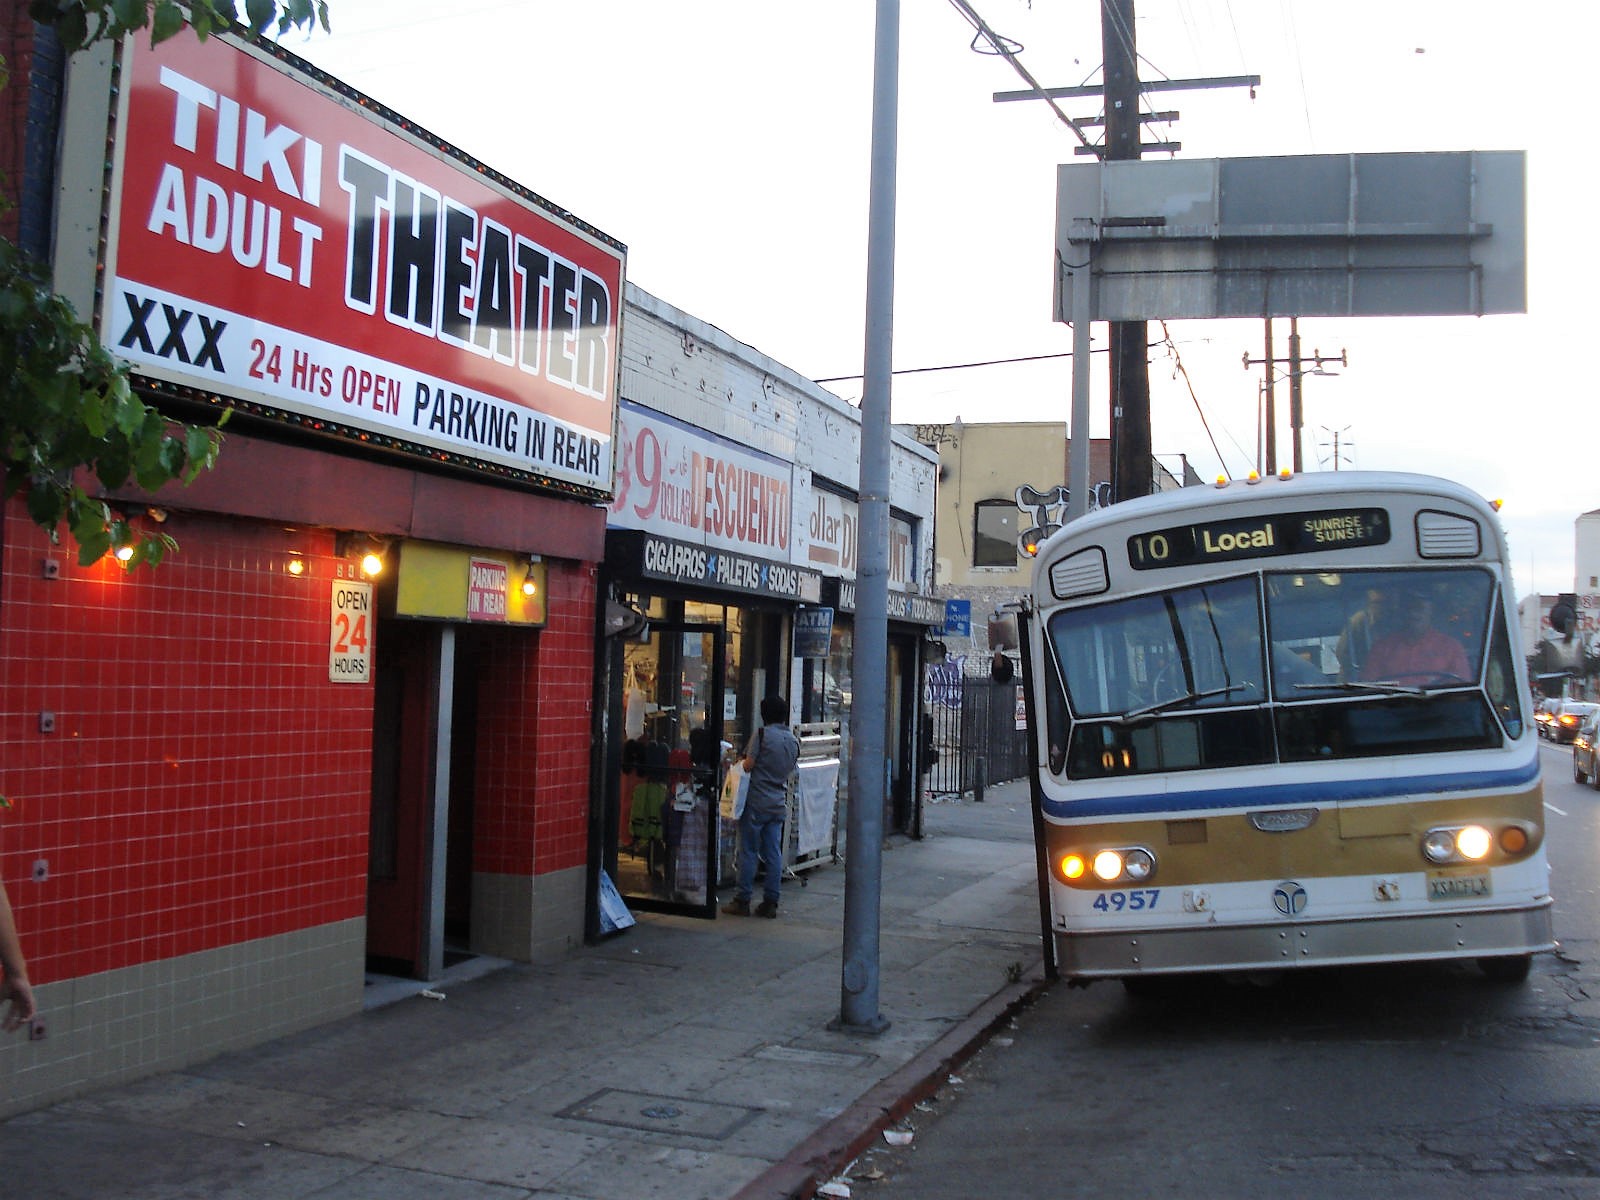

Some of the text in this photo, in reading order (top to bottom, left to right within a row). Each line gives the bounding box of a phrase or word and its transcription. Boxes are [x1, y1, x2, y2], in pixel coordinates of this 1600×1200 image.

[160, 65, 323, 208] TIKI
[148, 162, 323, 289] ADULT
[338, 143, 612, 402] THEATER
[117, 290, 601, 477] XXX 24 Hrs OPEN PARKING IN REAR
[690, 451, 789, 551] DESCUENTO
[1133, 523, 1275, 562] 10 Local
[1304, 515, 1362, 533] SUNRISE
[471, 566, 507, 592] PARKING
[644, 539, 707, 580] CIGARROS
[716, 555, 760, 589] PALETAS
[768, 565, 797, 595] SODAS
[337, 590, 368, 611] OPEN
[470, 591, 505, 615] IN REAR
[798, 611, 831, 627] ATM
[334, 612, 368, 654] 24
[334, 658, 365, 674] HOURS
[1093, 889, 1160, 912] 4957
